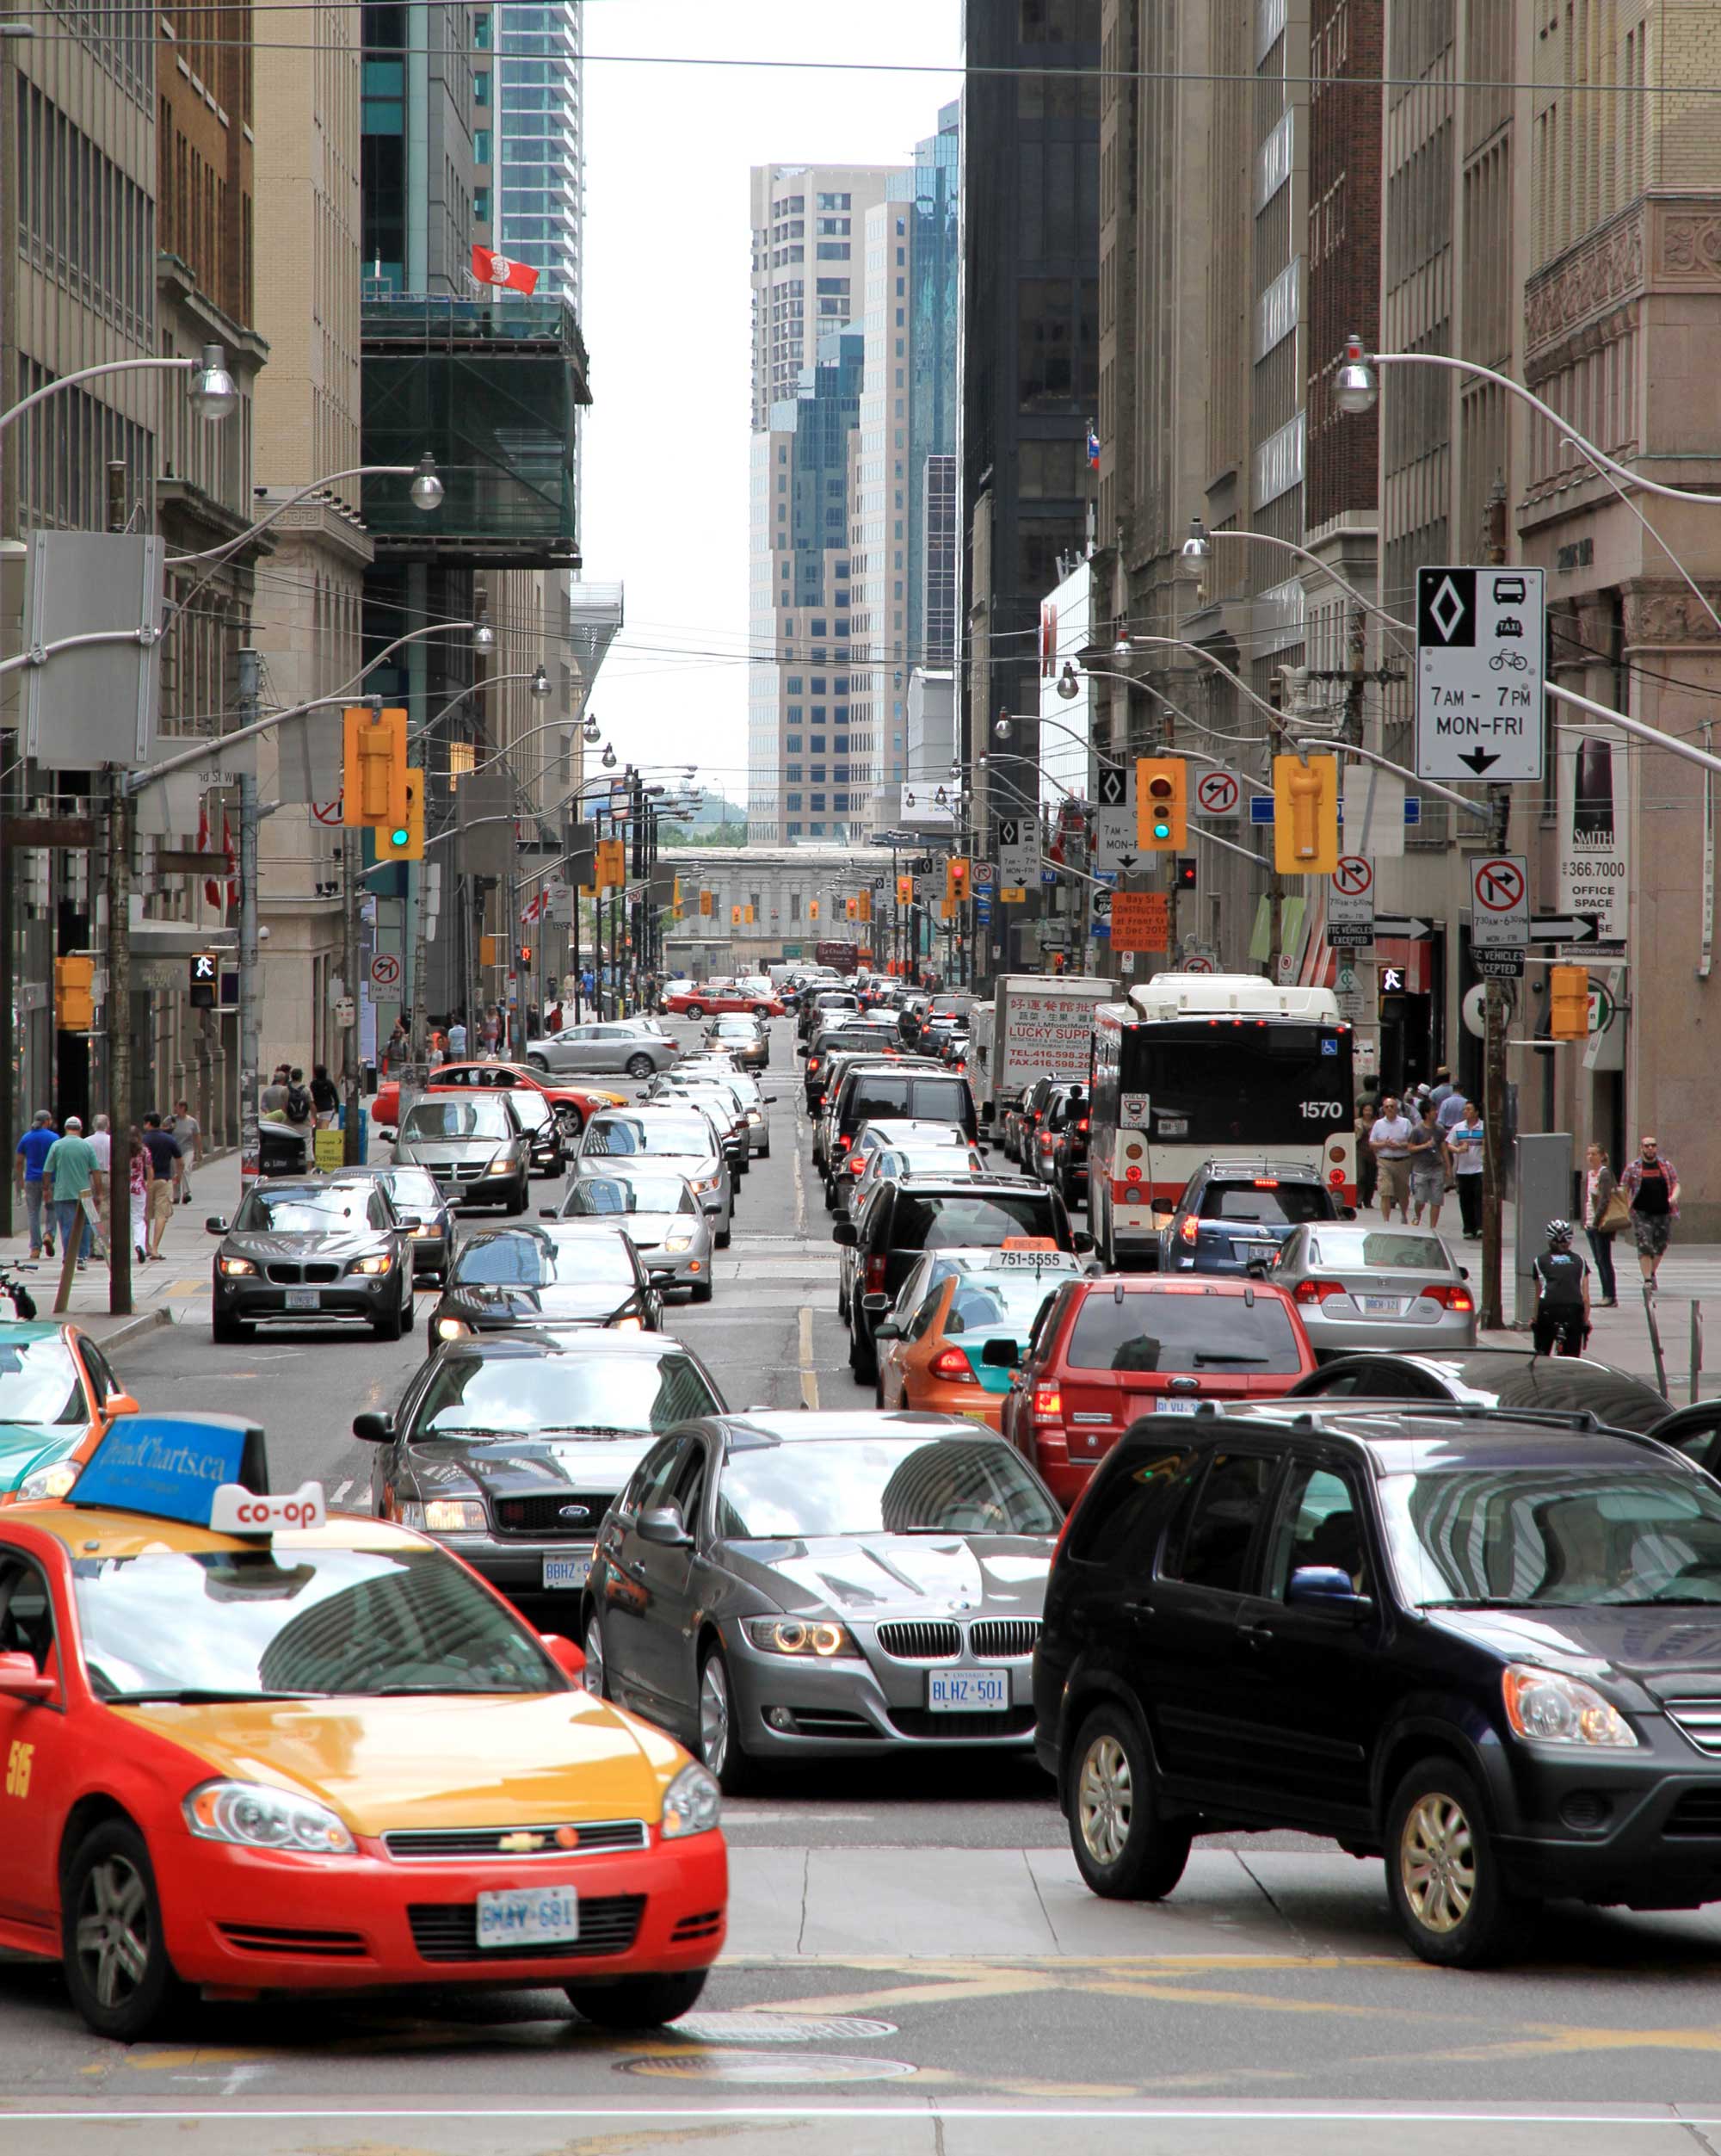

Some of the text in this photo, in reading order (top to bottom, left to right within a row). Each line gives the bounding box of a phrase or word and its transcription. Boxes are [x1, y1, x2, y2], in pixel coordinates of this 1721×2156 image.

[1500, 622, 1520, 631] TAXI
[1431, 686, 1465, 706] 7AM
[1497, 686, 1531, 706] 7PM
[1436, 716, 1523, 735] MON-FRI
[1575, 828, 1613, 844] SMITH
[1107, 840, 1138, 849] MON-F
[1570, 862, 1625, 877] 366.7000
[1572, 886, 1615, 895] OFFICE
[1575, 899, 1613, 908] SPACE
[1342, 925, 1372, 935] VEHICLES
[1334, 936, 1367, 944] EXCEPTED
[1484, 950, 1525, 961] VEHICLES
[1009, 1027, 1090, 1040] LUCKY SUPP
[1009, 1049, 1091, 1059] TEL.416.598.26
[1009, 1059, 1090, 1069] FAX.416.598.26
[1298, 1102, 1343, 1118] 1570
[1000, 1252, 1060, 1266] 751-5555
[237, 1501, 316, 1529] co-op
[933, 1680, 1003, 1700] BLHZ 501
